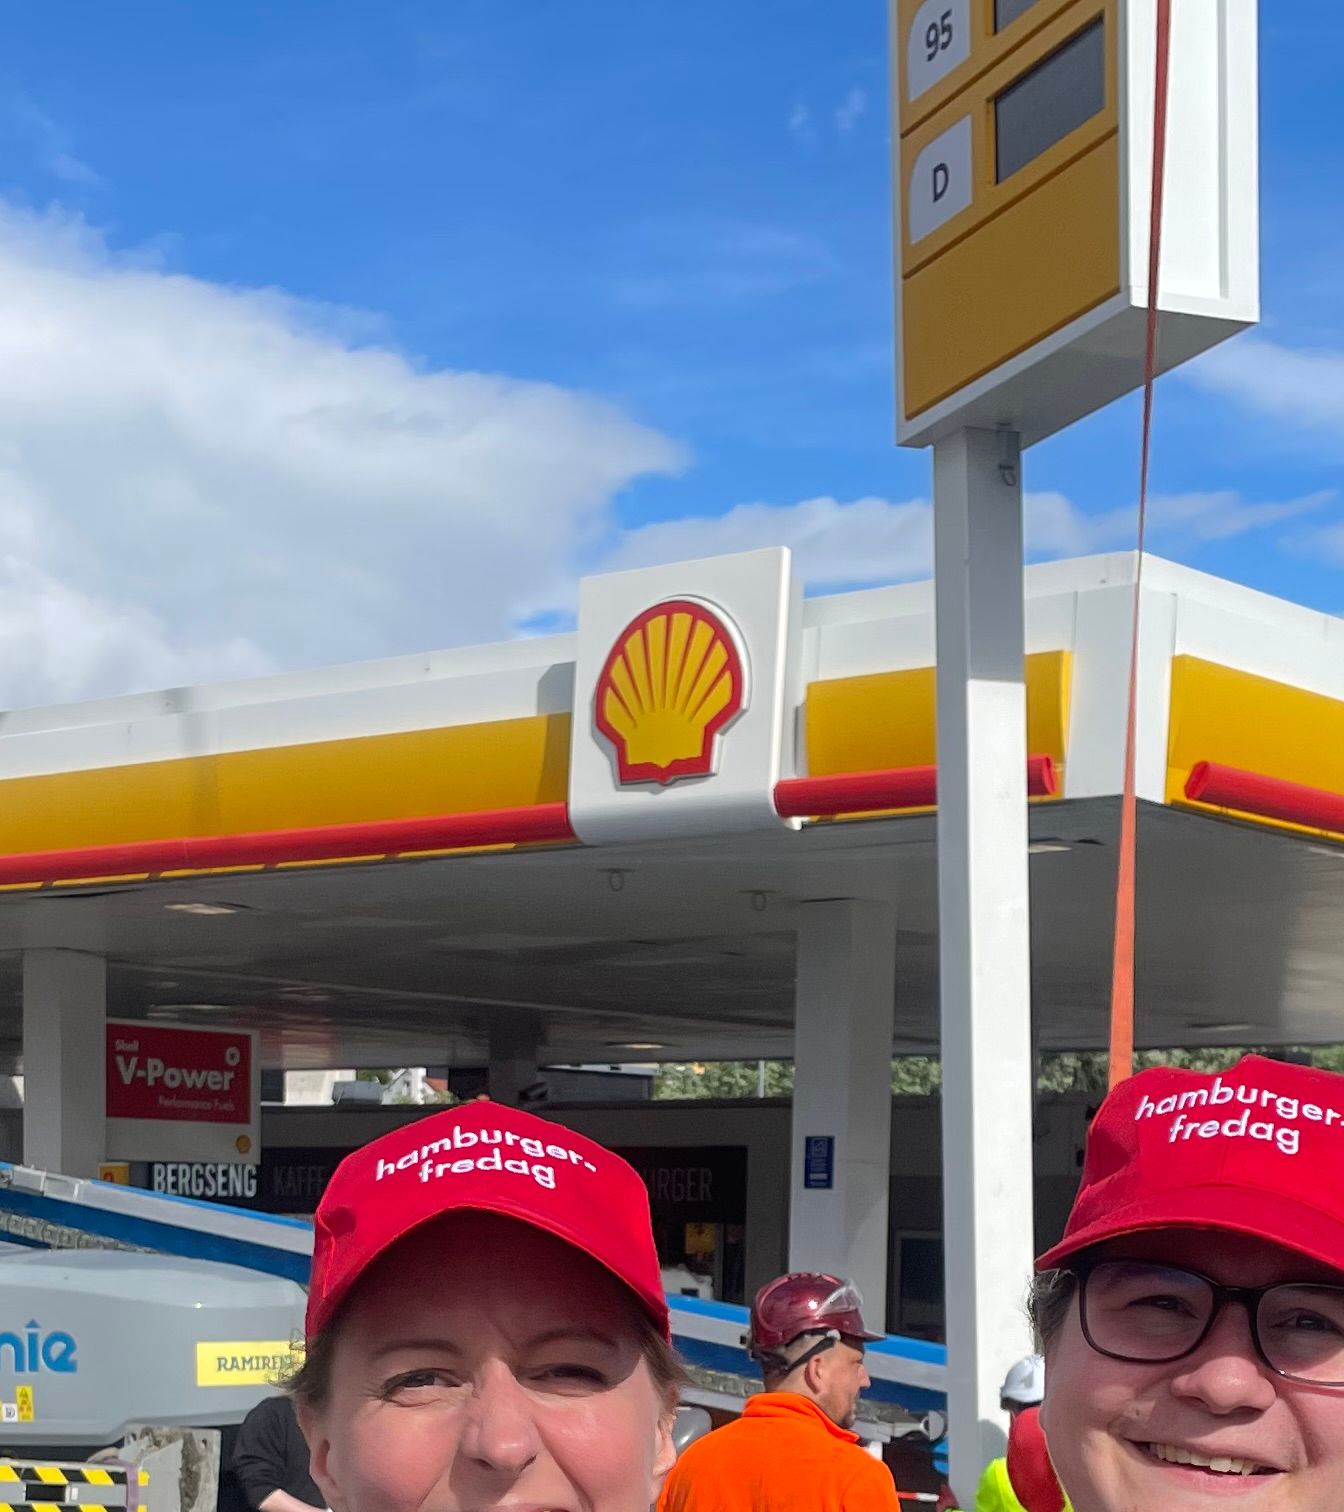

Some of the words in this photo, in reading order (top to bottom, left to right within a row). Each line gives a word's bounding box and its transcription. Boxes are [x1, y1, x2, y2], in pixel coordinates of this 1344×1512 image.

[926, 9, 953, 61] 95
[932, 162, 949, 203] D
[115, 1056, 235, 1091] V-Power
[1168, 1109, 1301, 1155] fredag
[154, 1163, 257, 1198] BERGSENG
[418, 1148, 557, 1189] fredag
[643, 1167, 713, 1202] URGER
[216, 1355, 292, 1372] RAMIREN
